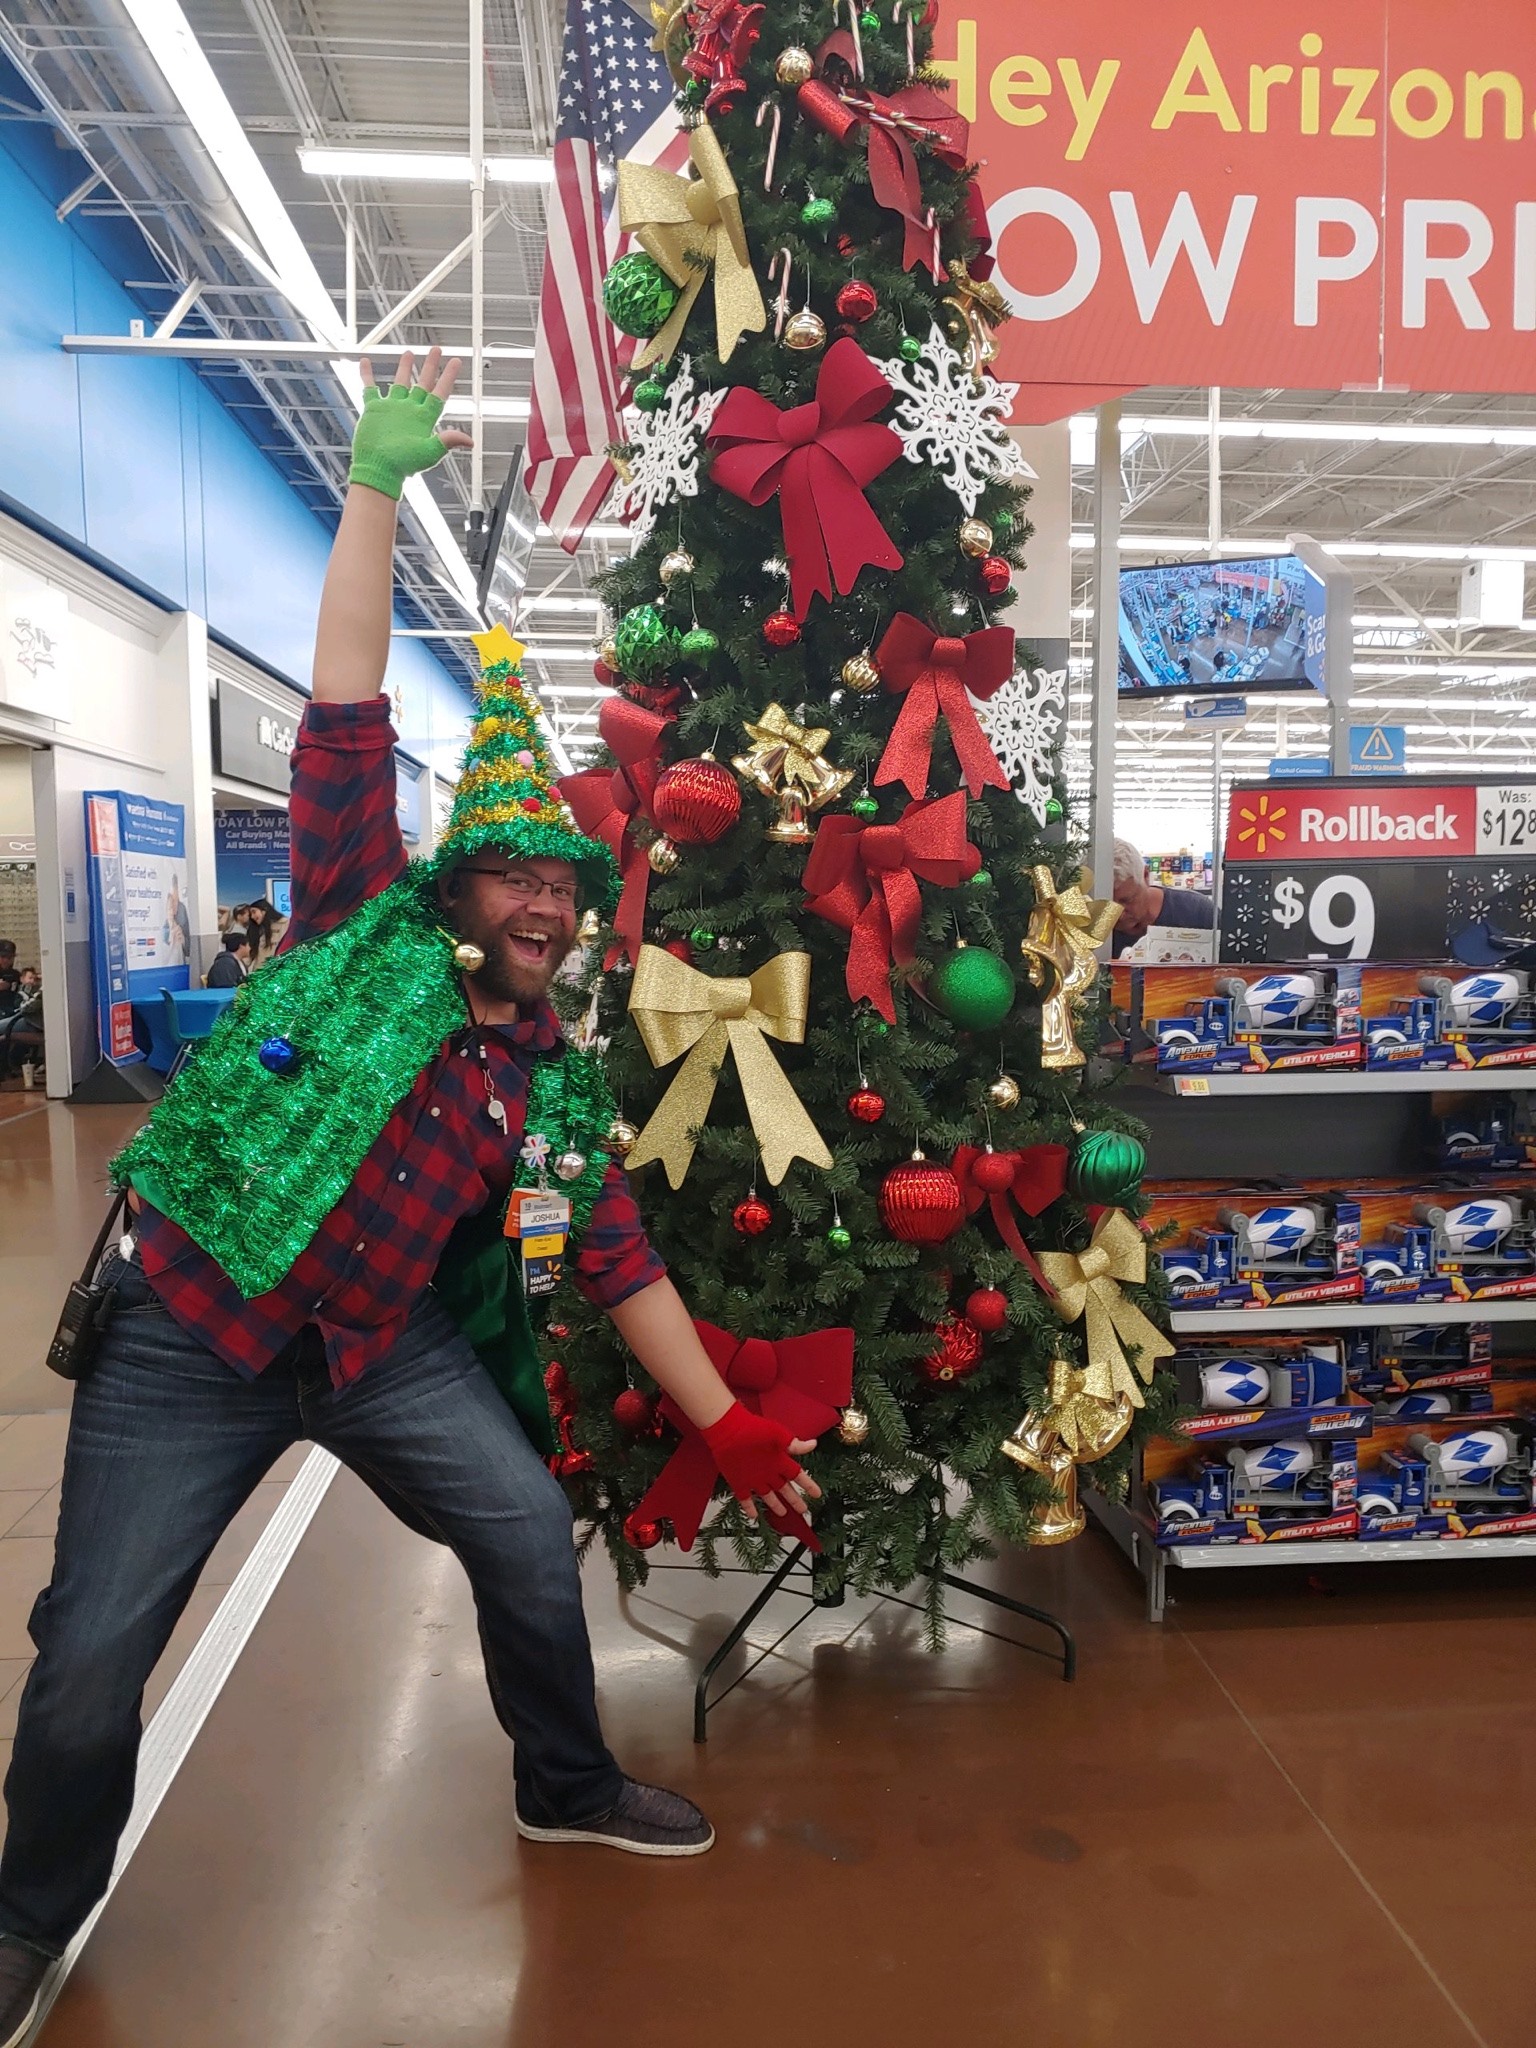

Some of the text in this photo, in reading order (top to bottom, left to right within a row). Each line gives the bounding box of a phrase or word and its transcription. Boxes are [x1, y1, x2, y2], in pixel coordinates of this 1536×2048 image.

[1151, 26, 1536, 140] Arizon
[1294, 196, 1536, 331] PRI
[1351, 764, 1372, 772] FRAUD
[1499, 789, 1532, 803] Was:
[246, 817, 275, 828] LOW
[1300, 805, 1459, 842] Rollback
[242, 831, 272, 840] Buying
[1166, 1043, 1219, 1058] ADVENTURE
[1283, 1050, 1355, 1065] UTILITY VEHICLE
[1374, 1043, 1425, 1058] ADVENTURE
[1488, 1053, 1523, 1063] UTILITY
[531, 1212, 560, 1223] JOSHUA
[530, 1274, 552, 1285] HAPPY
[1371, 1276, 1422, 1291] ADVENTURE
[530, 1282, 555, 1294] TO HELP
[1285, 1284, 1355, 1301] UTILITY VEHICLE
[1422, 1371, 1487, 1387] UTILITY VEHICLE
[1217, 1414, 1252, 1426] UTILITY
[1309, 1416, 1366, 1433] ADVENTURE
[1164, 1520, 1216, 1534] ADVENTURE
[1280, 1521, 1353, 1537] UTILITY VEHICLE
[1367, 1514, 1419, 1529] ADVENTURE
